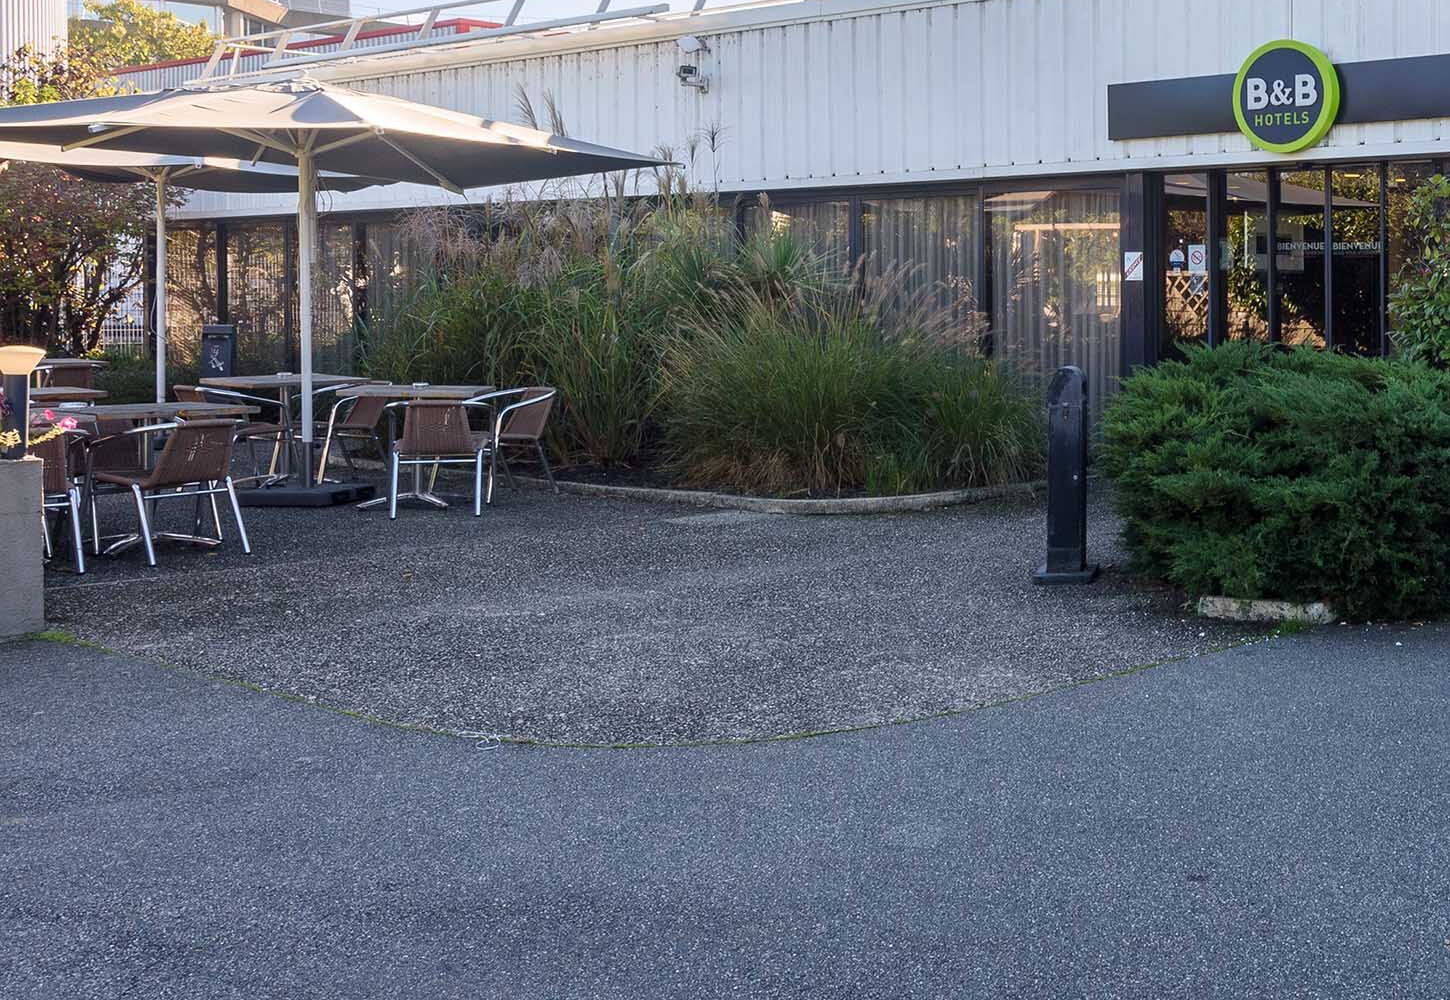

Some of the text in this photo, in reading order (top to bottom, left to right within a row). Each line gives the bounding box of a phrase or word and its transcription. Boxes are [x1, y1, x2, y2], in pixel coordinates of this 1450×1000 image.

[1247, 73, 1318, 110] B&B
[1255, 111, 1309, 126] HOTELS
[1277, 242, 1325, 250] BIENVENUE
